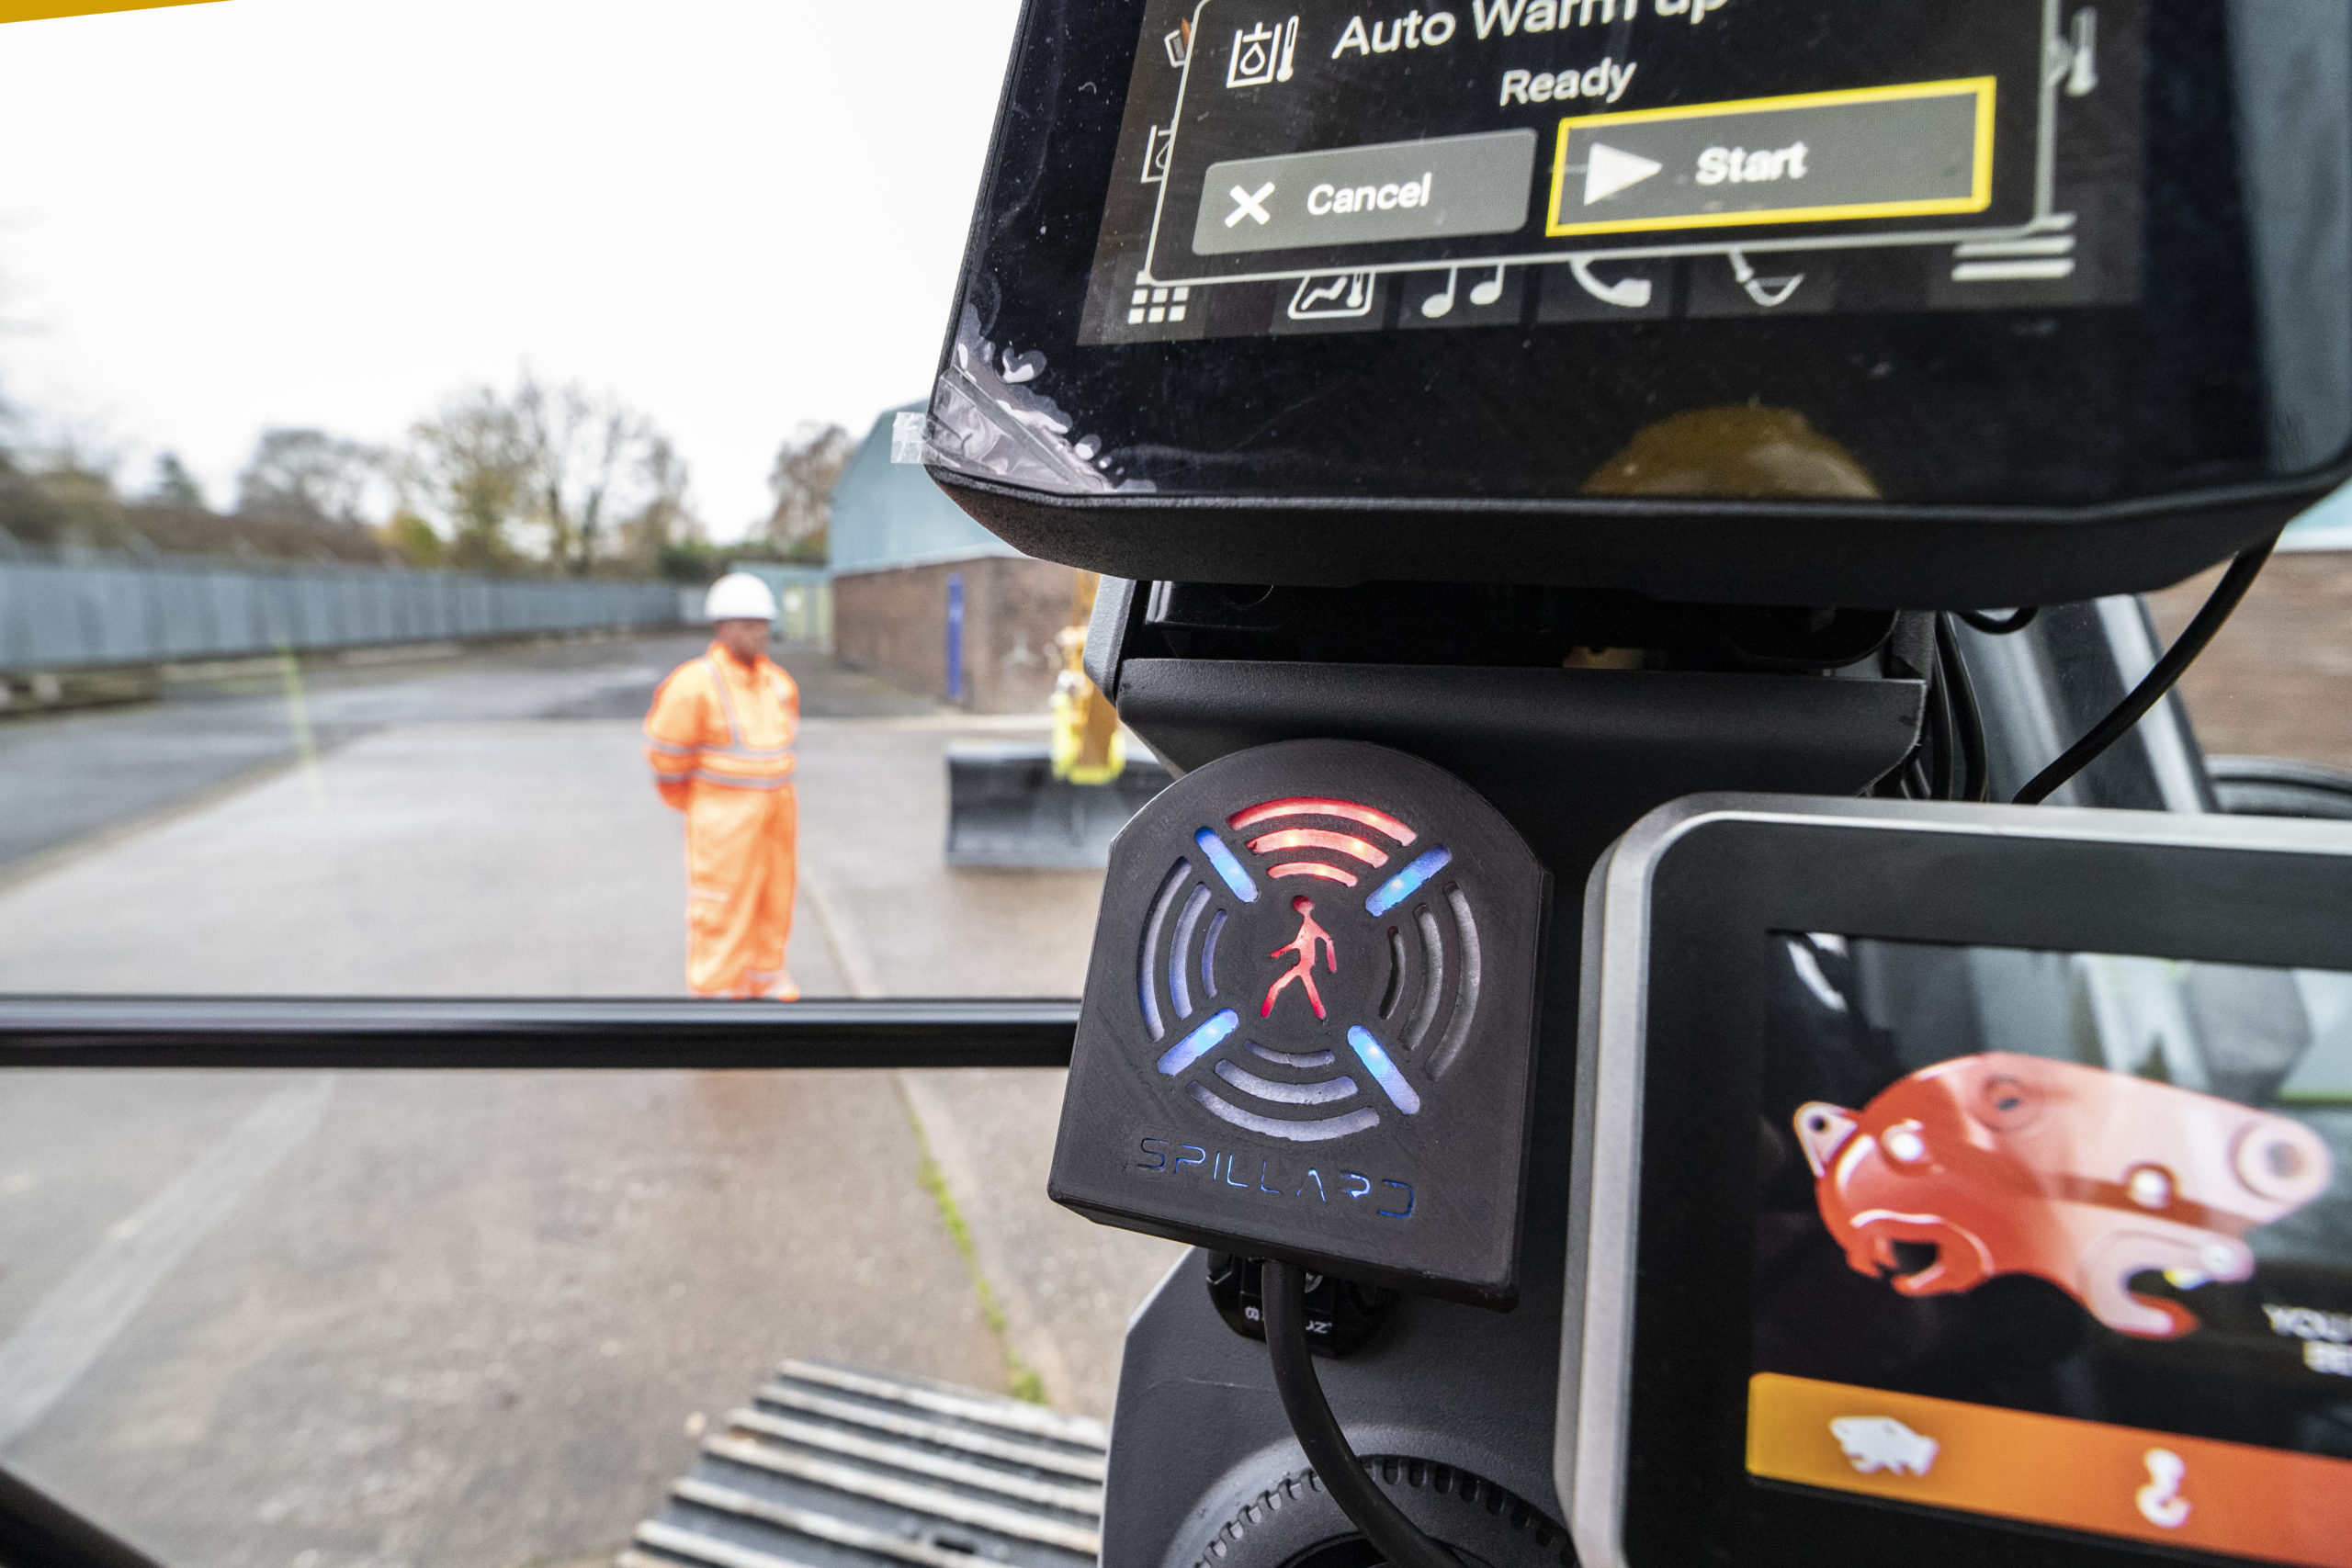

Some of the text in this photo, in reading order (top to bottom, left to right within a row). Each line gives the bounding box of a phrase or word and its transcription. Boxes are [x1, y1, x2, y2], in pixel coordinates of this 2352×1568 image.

[1331, 10, 1456, 60] Auto
[1472, 0, 1638, 39] Warm
[1499, 57, 1637, 107] Ready
[1695, 141, 1808, 186] Start
[1306, 172, 1432, 217] Cancel
[1136, 1136, 1416, 1220] SPILLARD
